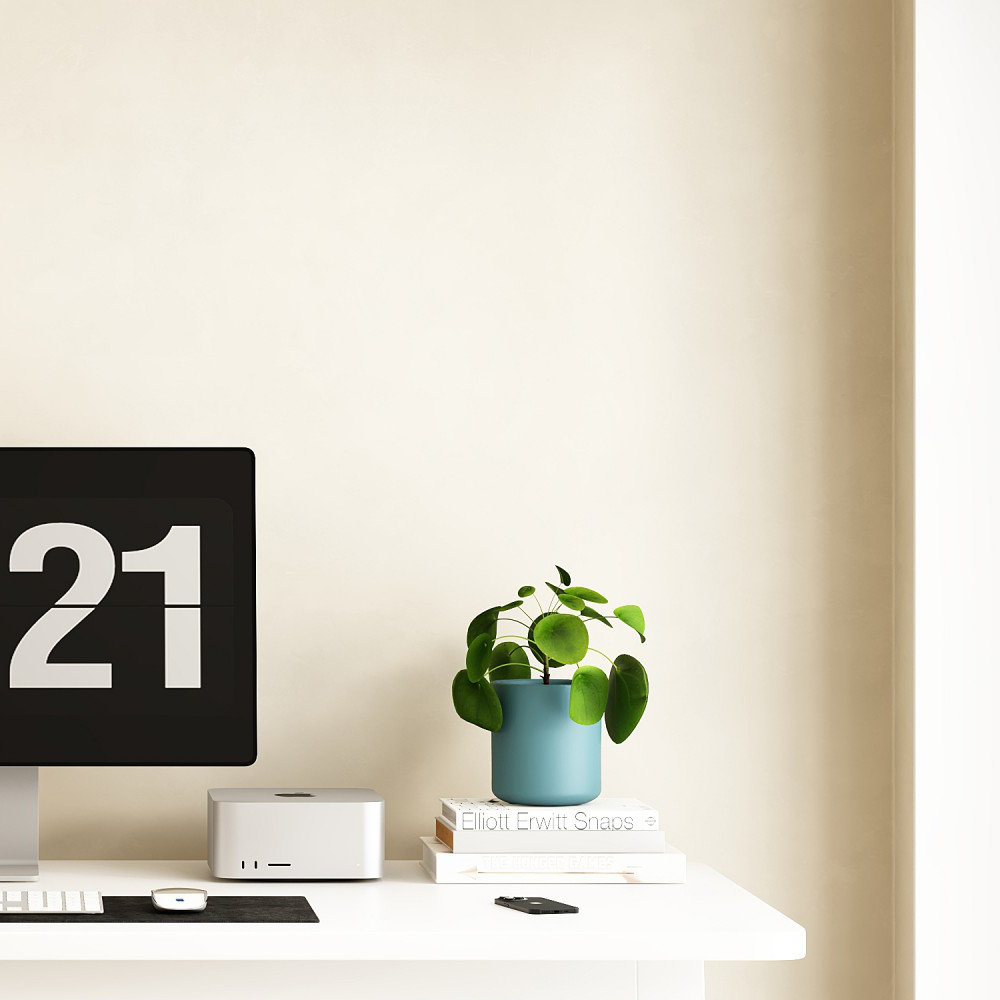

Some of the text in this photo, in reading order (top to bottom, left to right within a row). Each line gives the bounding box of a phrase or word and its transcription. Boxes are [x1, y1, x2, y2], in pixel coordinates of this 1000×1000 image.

[8, 522, 202, 689] 21
[462, 811, 510, 830] Elliott
[517, 811, 567, 830] Erwitt
[574, 811, 634, 831] Snaps
